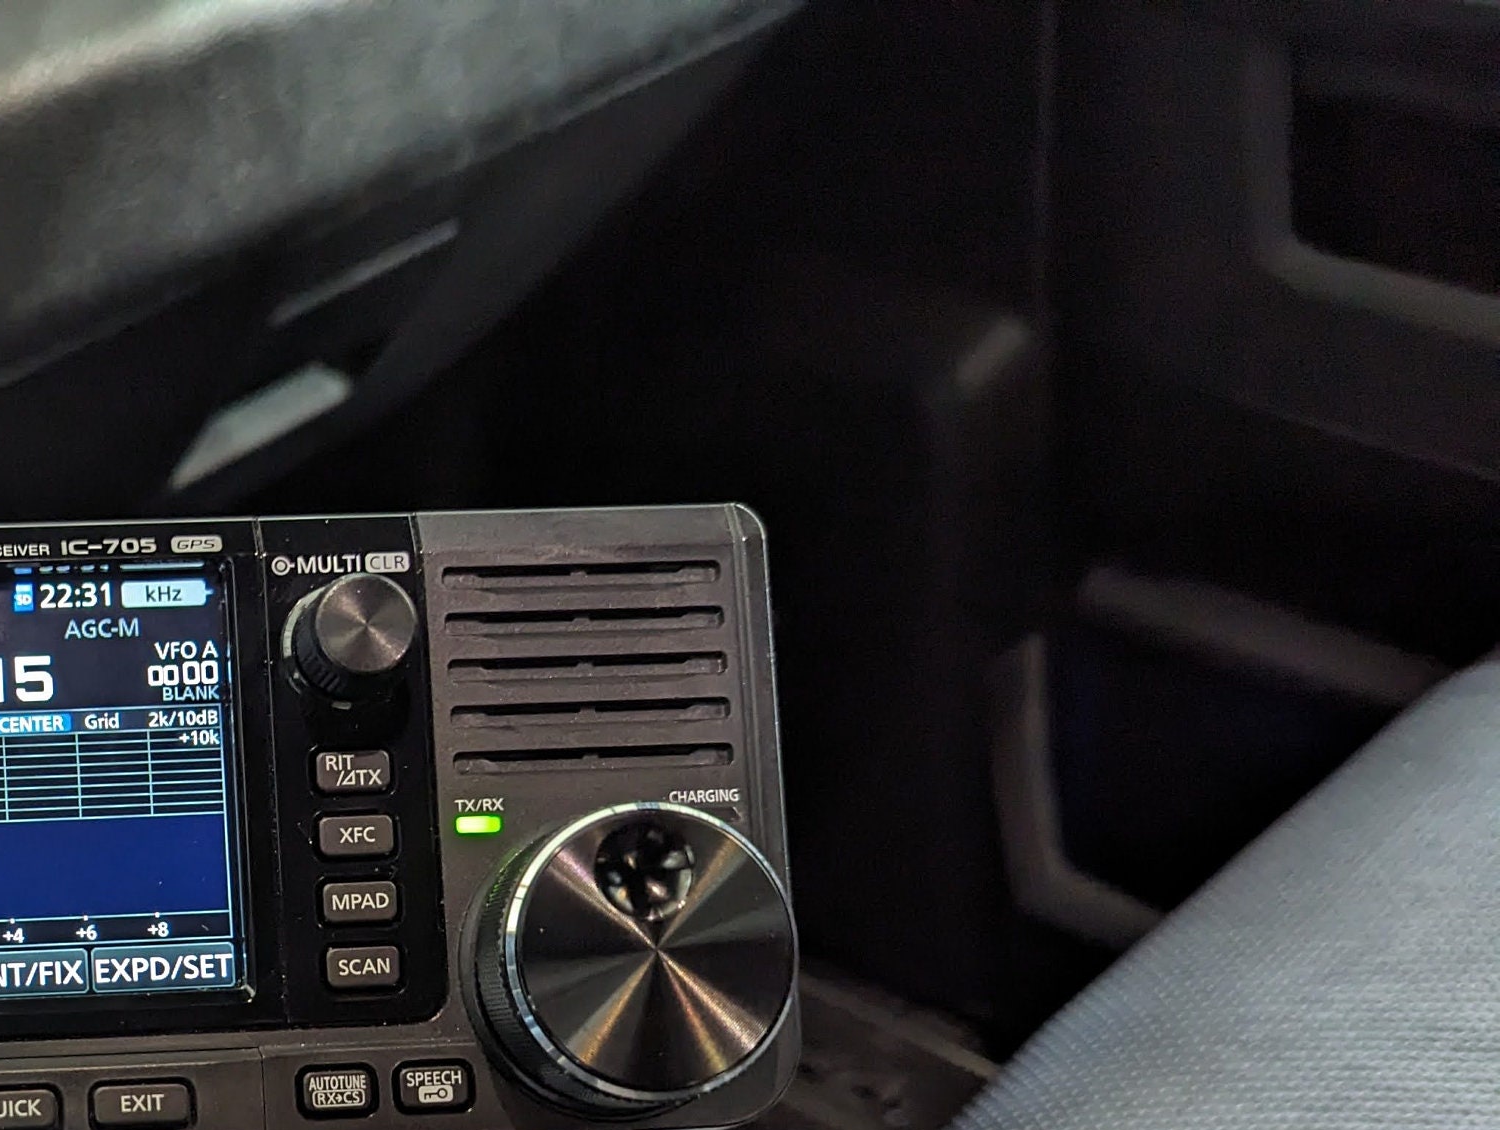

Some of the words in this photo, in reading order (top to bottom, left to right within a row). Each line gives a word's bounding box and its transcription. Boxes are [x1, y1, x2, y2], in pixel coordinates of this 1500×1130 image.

[60, 537, 158, 556] IC-705
[176, 538, 217, 551] GPS
[297, 555, 362, 574] MULTI
[369, 555, 406, 570] CLR
[39, 582, 113, 609] 22:31
[145, 585, 182, 603] kHz
[64, 617, 140, 639] AGC-M
[154, 642, 197, 660] VFO
[202, 640, 219, 658] A
[162, 685, 220, 702] BLANK
[84, 713, 120, 730] Grid
[148, 710, 219, 728] 2k/10dB
[178, 730, 220, 746] +10k
[325, 754, 355, 771] RIT
[455, 797, 504, 812] TX/RX
[668, 788, 739, 804] CHARGING
[340, 827, 377, 844] XFC
[331, 892, 390, 911] MPAD
[2, 928, 25, 944] +4
[75, 924, 98, 941] +6
[147, 921, 169, 938] +8
[95, 953, 233, 984] EXPD/SET
[338, 957, 391, 976] SCAN
[308, 1074, 367, 1091] AUTOTUNE
[406, 1070, 463, 1086] SPEECH
[120, 1093, 165, 1113] EXIT
